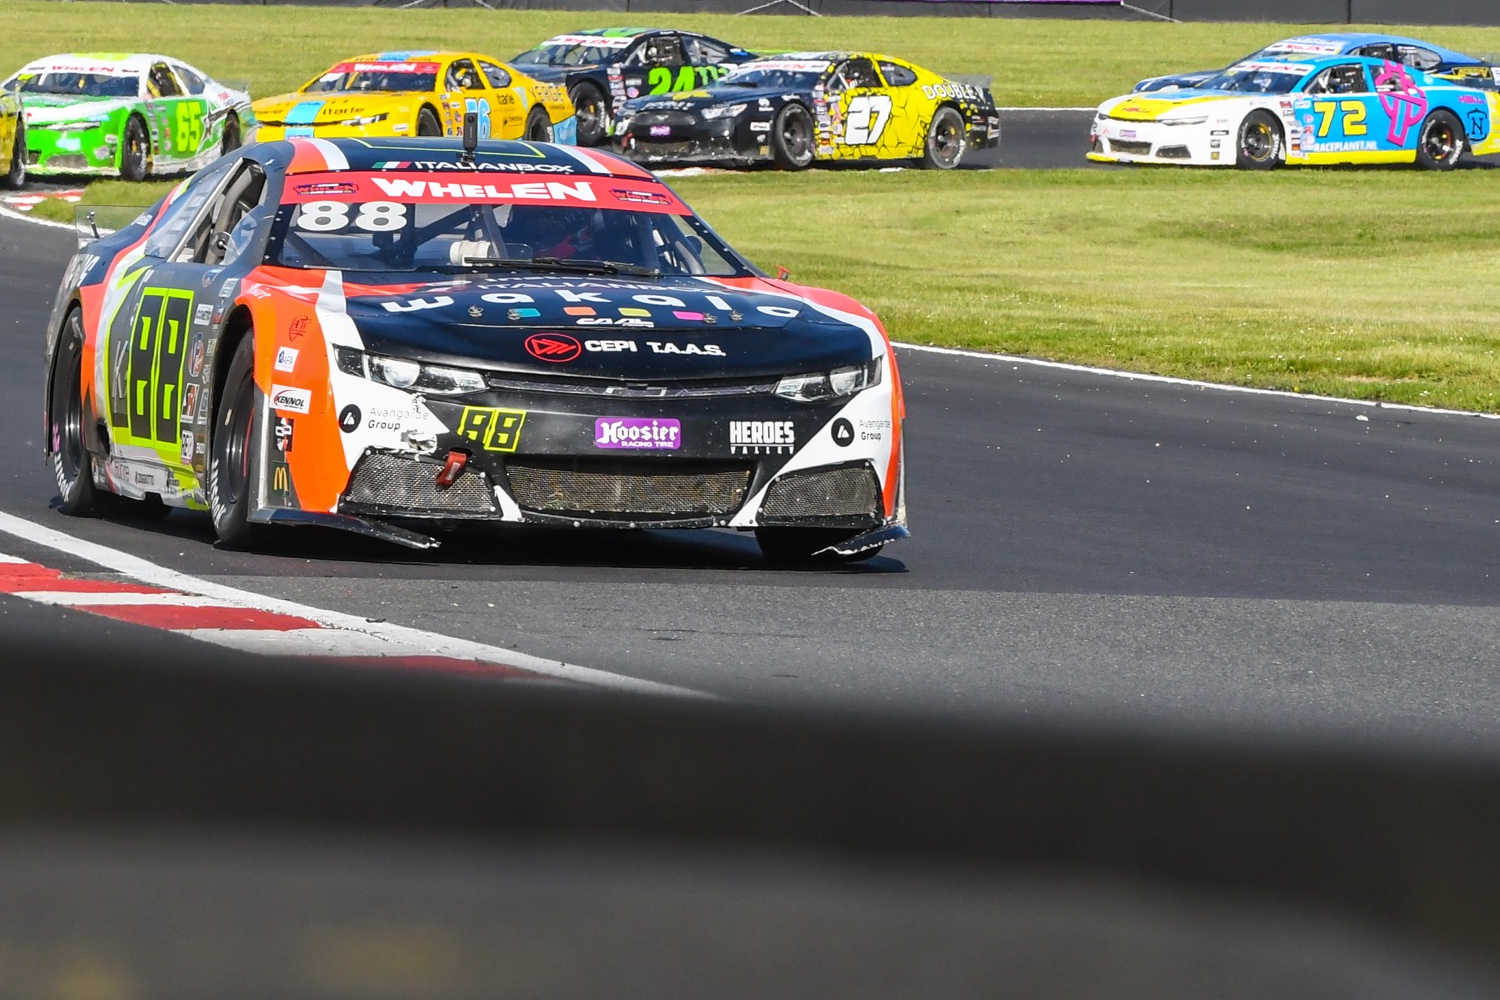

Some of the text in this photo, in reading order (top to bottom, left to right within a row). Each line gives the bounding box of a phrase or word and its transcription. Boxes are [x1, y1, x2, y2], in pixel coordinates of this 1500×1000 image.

[649, 66, 695, 96] 24
[922, 83, 971, 100] DOUBLE
[176, 101, 201, 152] 65
[845, 96, 892, 145] 27
[1313, 100, 1367, 138] 72
[1314, 140, 1378, 152] RACEPLANET.NL
[414, 160, 574, 174] ITALIANBOX
[369, 177, 598, 202] WHELEN
[297, 200, 408, 231] 88
[584, 339, 727, 357] CEPI T.A.A.S.
[276, 395, 306, 408] KENNOL
[368, 420, 401, 431] Group
[596, 420, 679, 445] Hoosier
[729, 420, 795, 443] HEROES
[621, 440, 674, 448] RACING TIRE
[861, 431, 882, 442] Group
